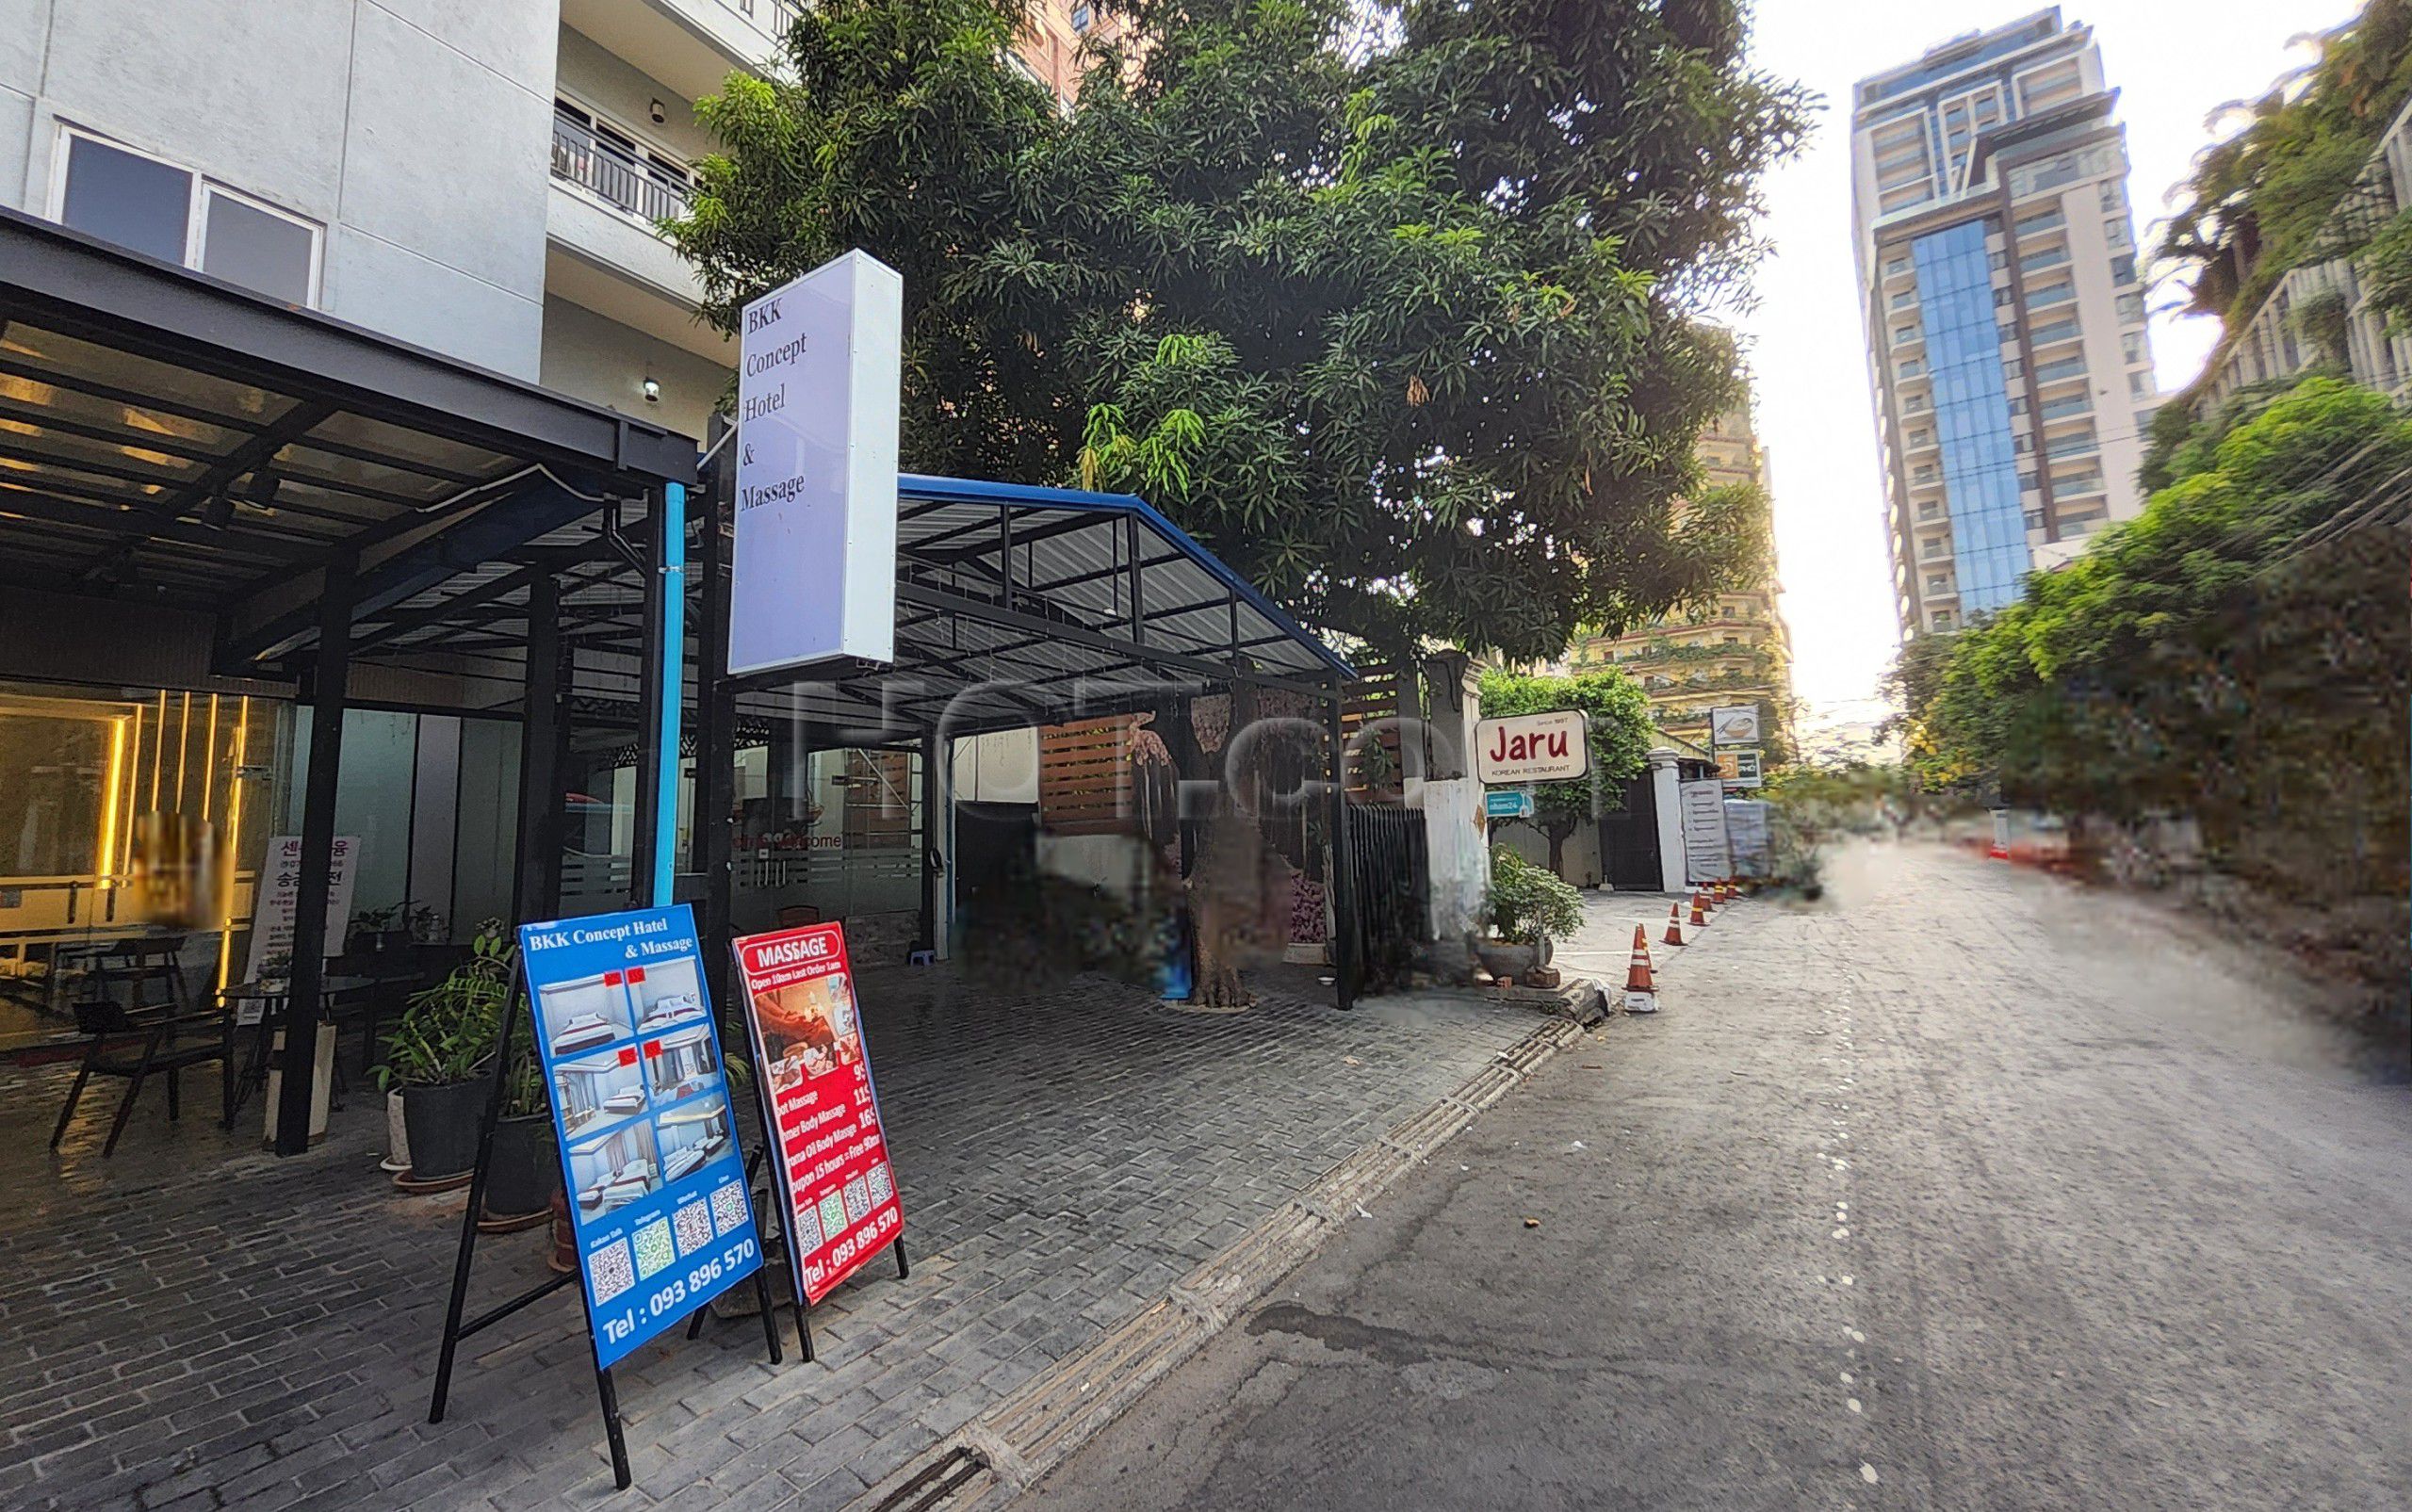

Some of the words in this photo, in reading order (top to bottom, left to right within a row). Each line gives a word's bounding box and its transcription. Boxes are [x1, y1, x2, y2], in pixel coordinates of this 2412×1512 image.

[748, 298, 782, 335] BKK
[746, 332, 807, 378] Concept
[744, 384, 786, 424] Hotel
[742, 443, 755, 466] &
[741, 473, 805, 512] Massage
[1490, 725, 1569, 762] Jaru
[1523, 765, 1570, 774] RESTAURANT
[530, 932, 571, 951] BKK
[573, 927, 630, 944] Concept
[626, 944, 639, 959] &
[641, 938, 693, 956] Massage
[758, 936, 828, 968] MASSAGE
[752, 977, 771, 991] Open
[791, 968, 807, 980] Last
[807, 965, 825, 975] Order
[806, 1142, 816, 1158] Oil
[791, 1172, 815, 1193] oupon
[814, 1162, 825, 1180] 15
[823, 1153, 844, 1175] hours
[805, 1259, 825, 1286] Tel
[833, 1238, 856, 1267] 093
[856, 1221, 878, 1249] 896
[877, 1206, 897, 1234] 570
[603, 1308, 635, 1344] Tel
[650, 1279, 686, 1317] 093
[689, 1258, 722, 1293] 896
[724, 1238, 754, 1272] 570
